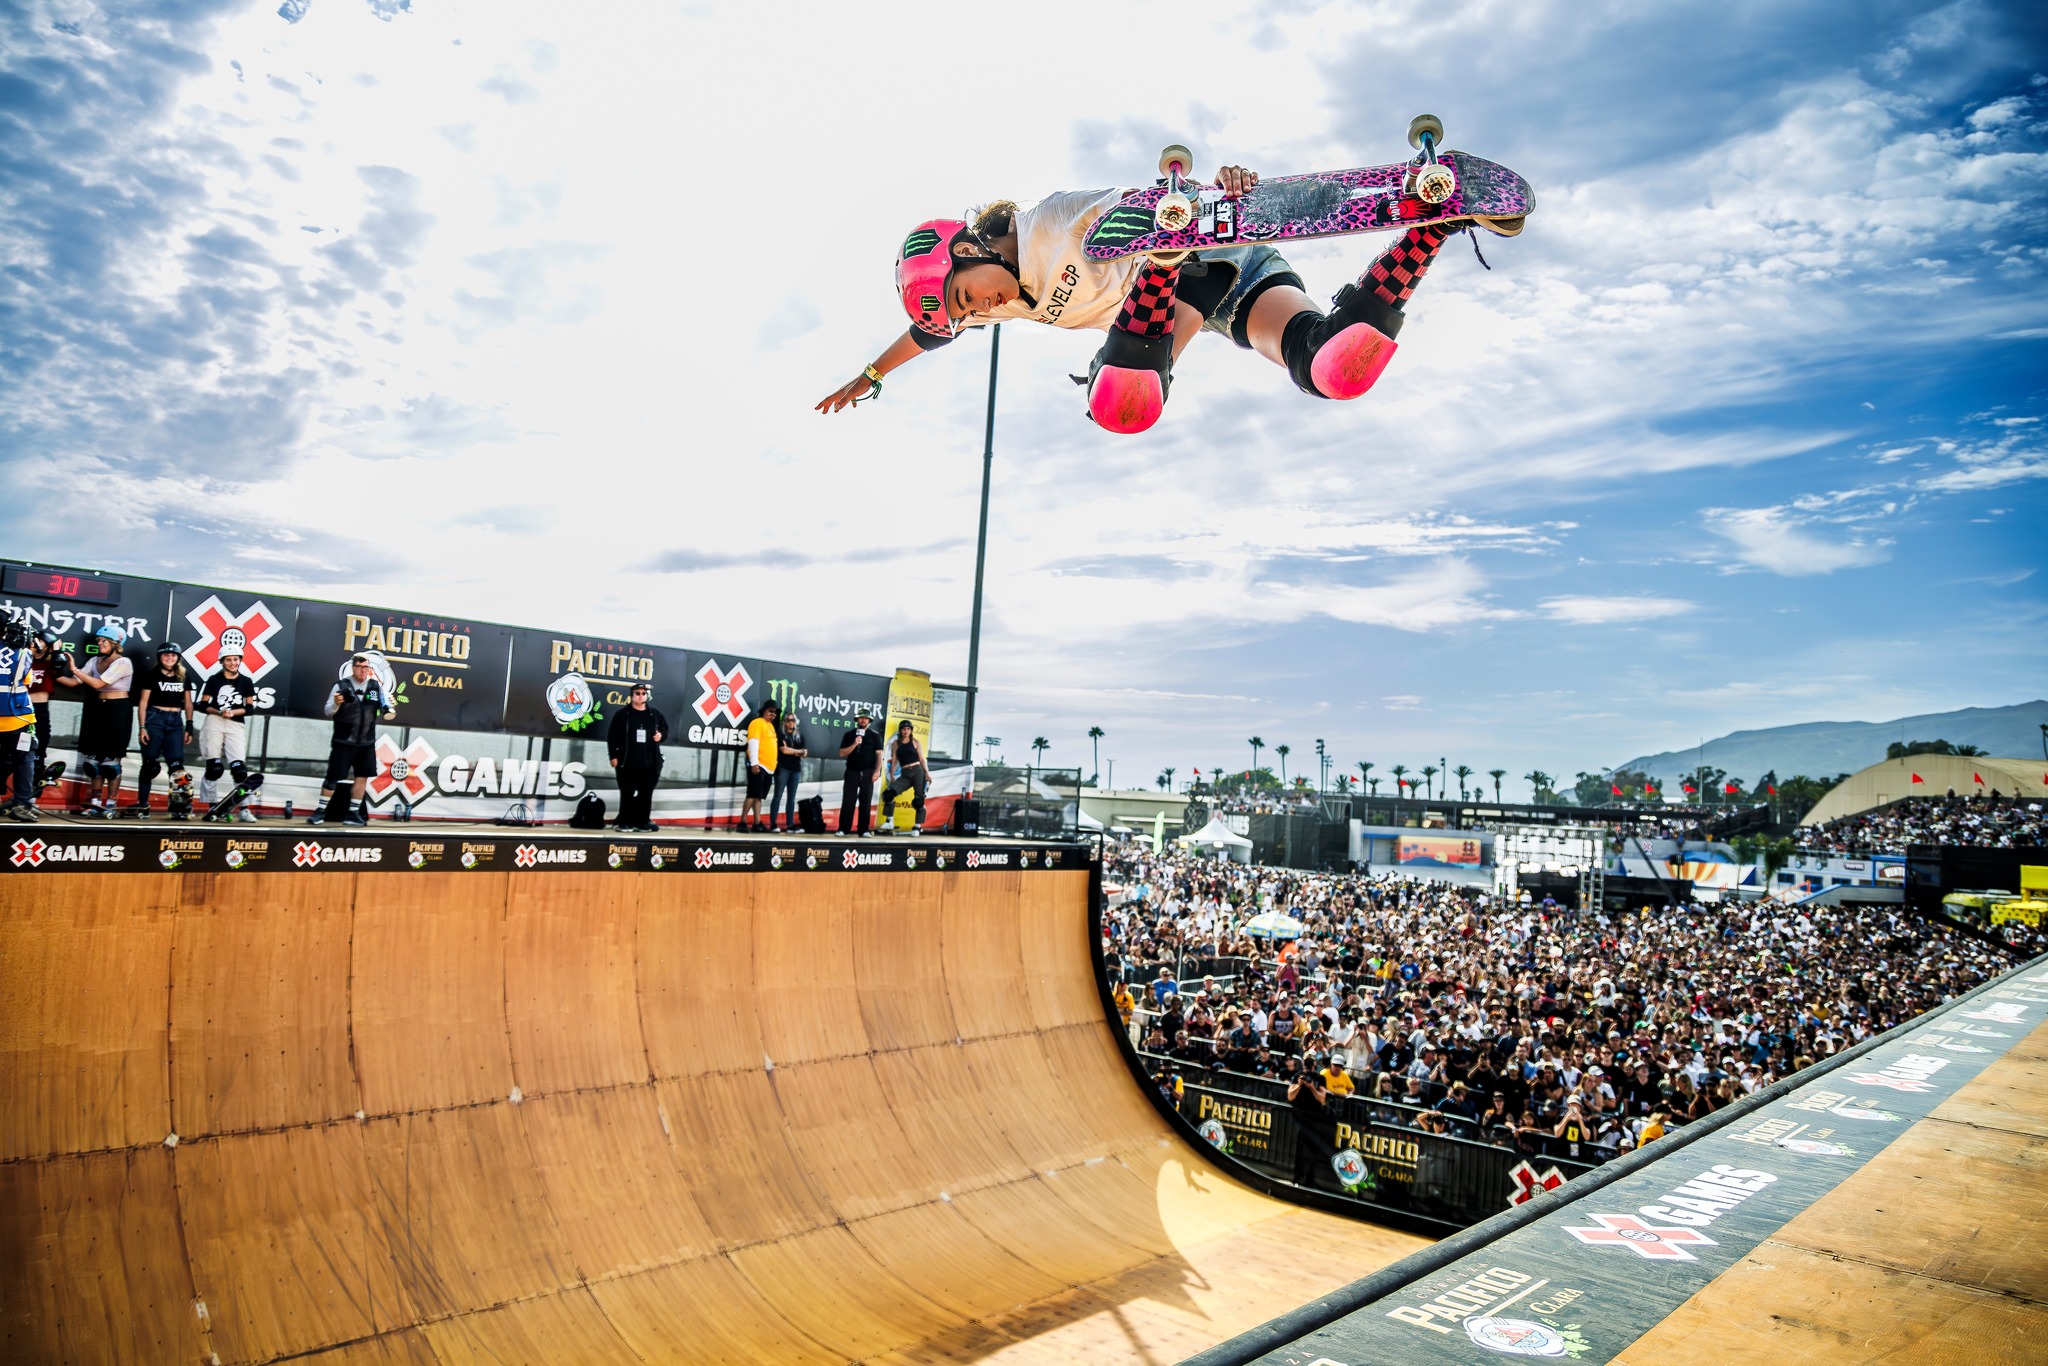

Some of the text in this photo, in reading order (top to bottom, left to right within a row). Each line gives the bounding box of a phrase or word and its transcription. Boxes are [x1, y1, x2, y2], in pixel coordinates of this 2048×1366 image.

[47, 574, 79, 597] 30
[387, 616, 471, 633] CERVEZA
[344, 614, 471, 660] PACIFICO
[550, 640, 654, 680] PACIFICO
[158, 681, 184, 692] VANS
[412, 671, 463, 690] CLARA
[606, 690, 631, 705] CLA
[688, 725, 748, 747] GAMES
[437, 754, 588, 798] GAMES
[46, 845, 125, 862] GAMES
[320, 847, 382, 863] GAMES
[536, 849, 587, 864] GAMES
[712, 852, 754, 865] GAMES
[858, 853, 892, 866] GAMES
[979, 853, 1009, 865] GAMES
[1199, 1094, 1272, 1130] PACIFICO
[1335, 1122, 1419, 1162] PACIFICO
[1639, 1164, 1778, 1227] GAMES
[1385, 1266, 1532, 1334] PACIFICO
[1529, 1287, 1585, 1315] CLARA
